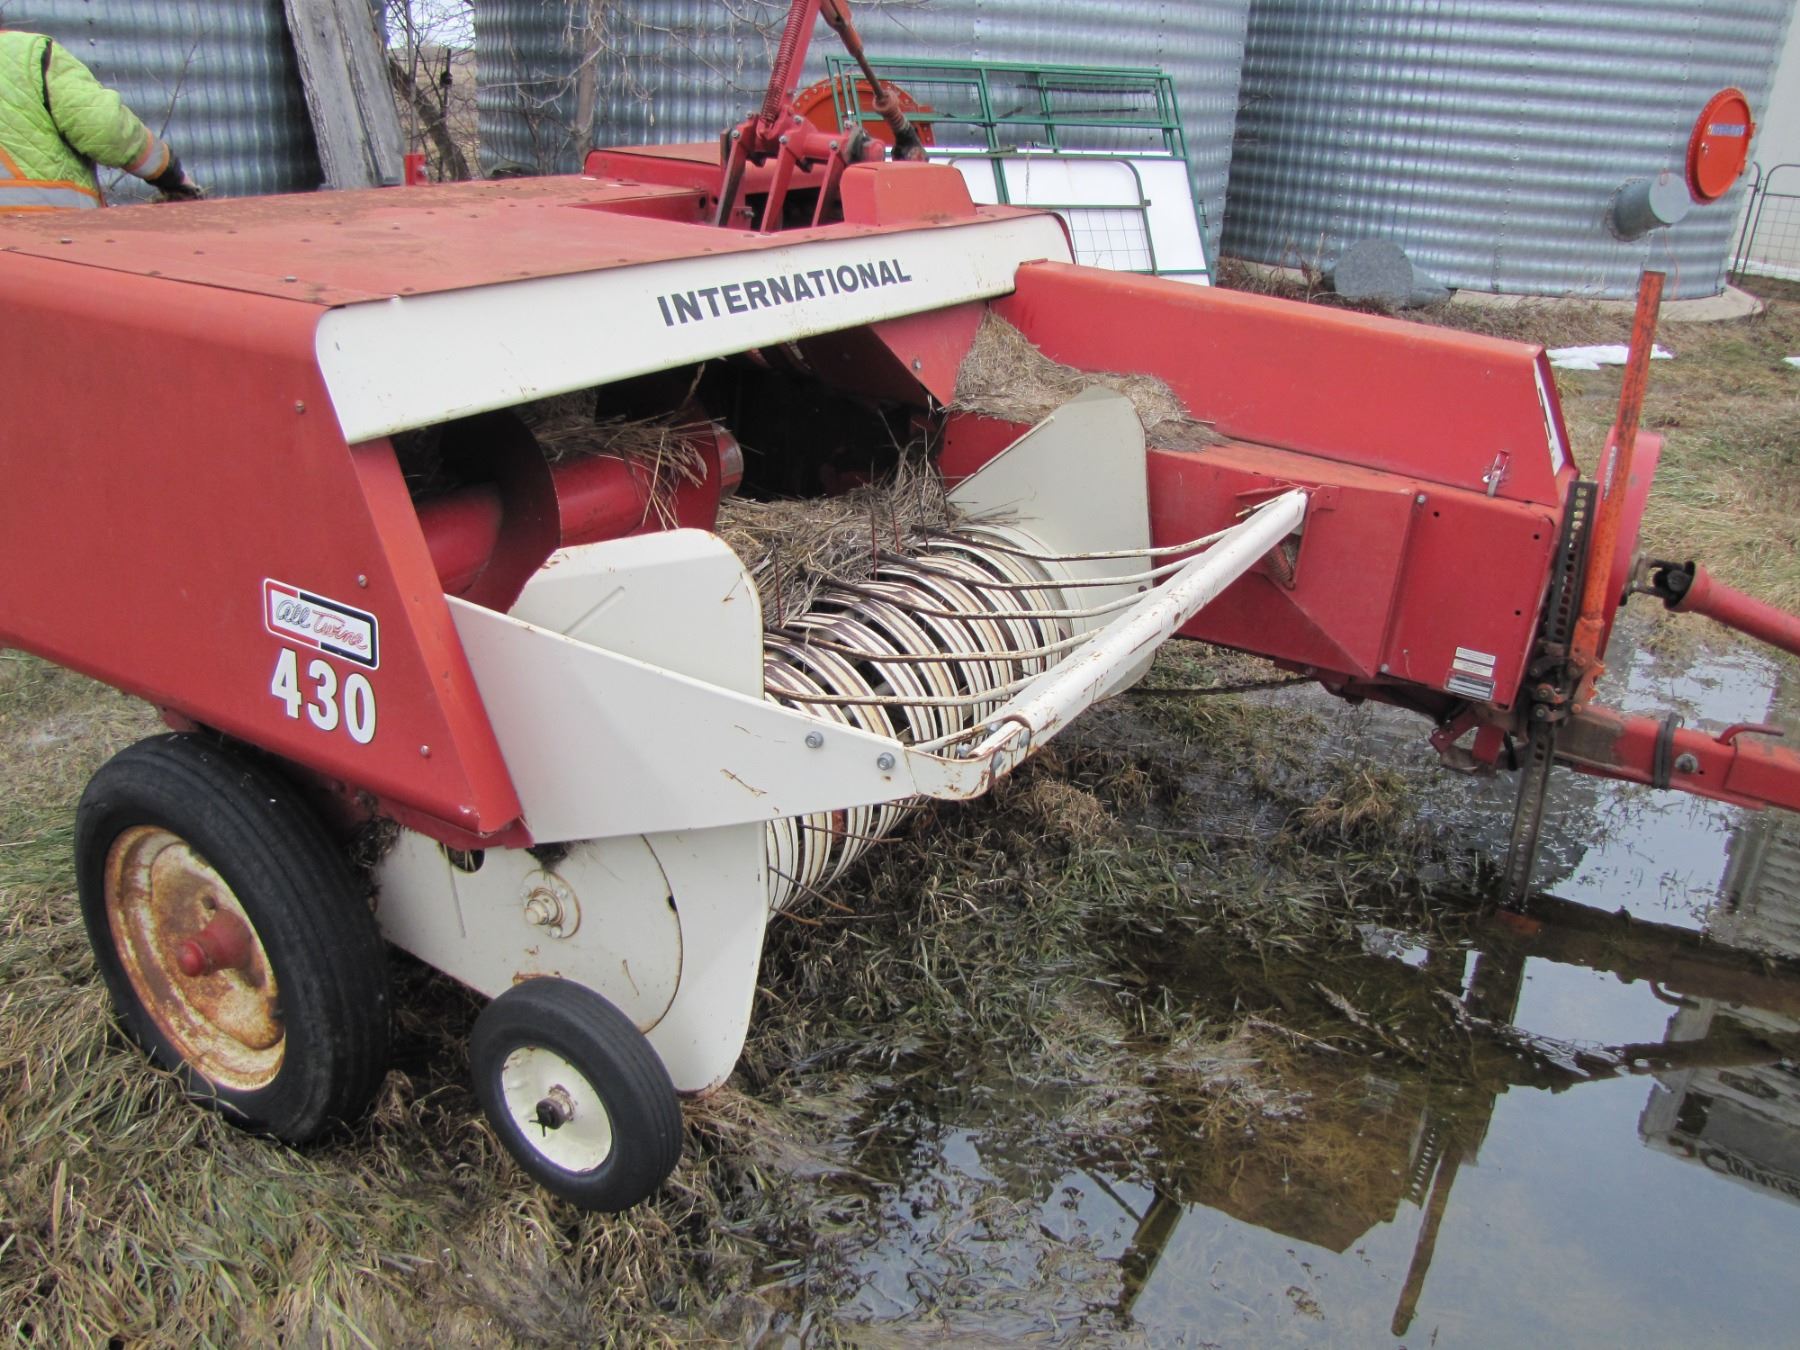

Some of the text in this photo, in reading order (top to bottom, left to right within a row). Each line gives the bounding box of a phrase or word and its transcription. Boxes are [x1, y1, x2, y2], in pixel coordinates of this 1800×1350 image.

[657, 259, 912, 327] INTERNATIONAL
[312, 609, 368, 650] Twine
[271, 647, 376, 744] 430
